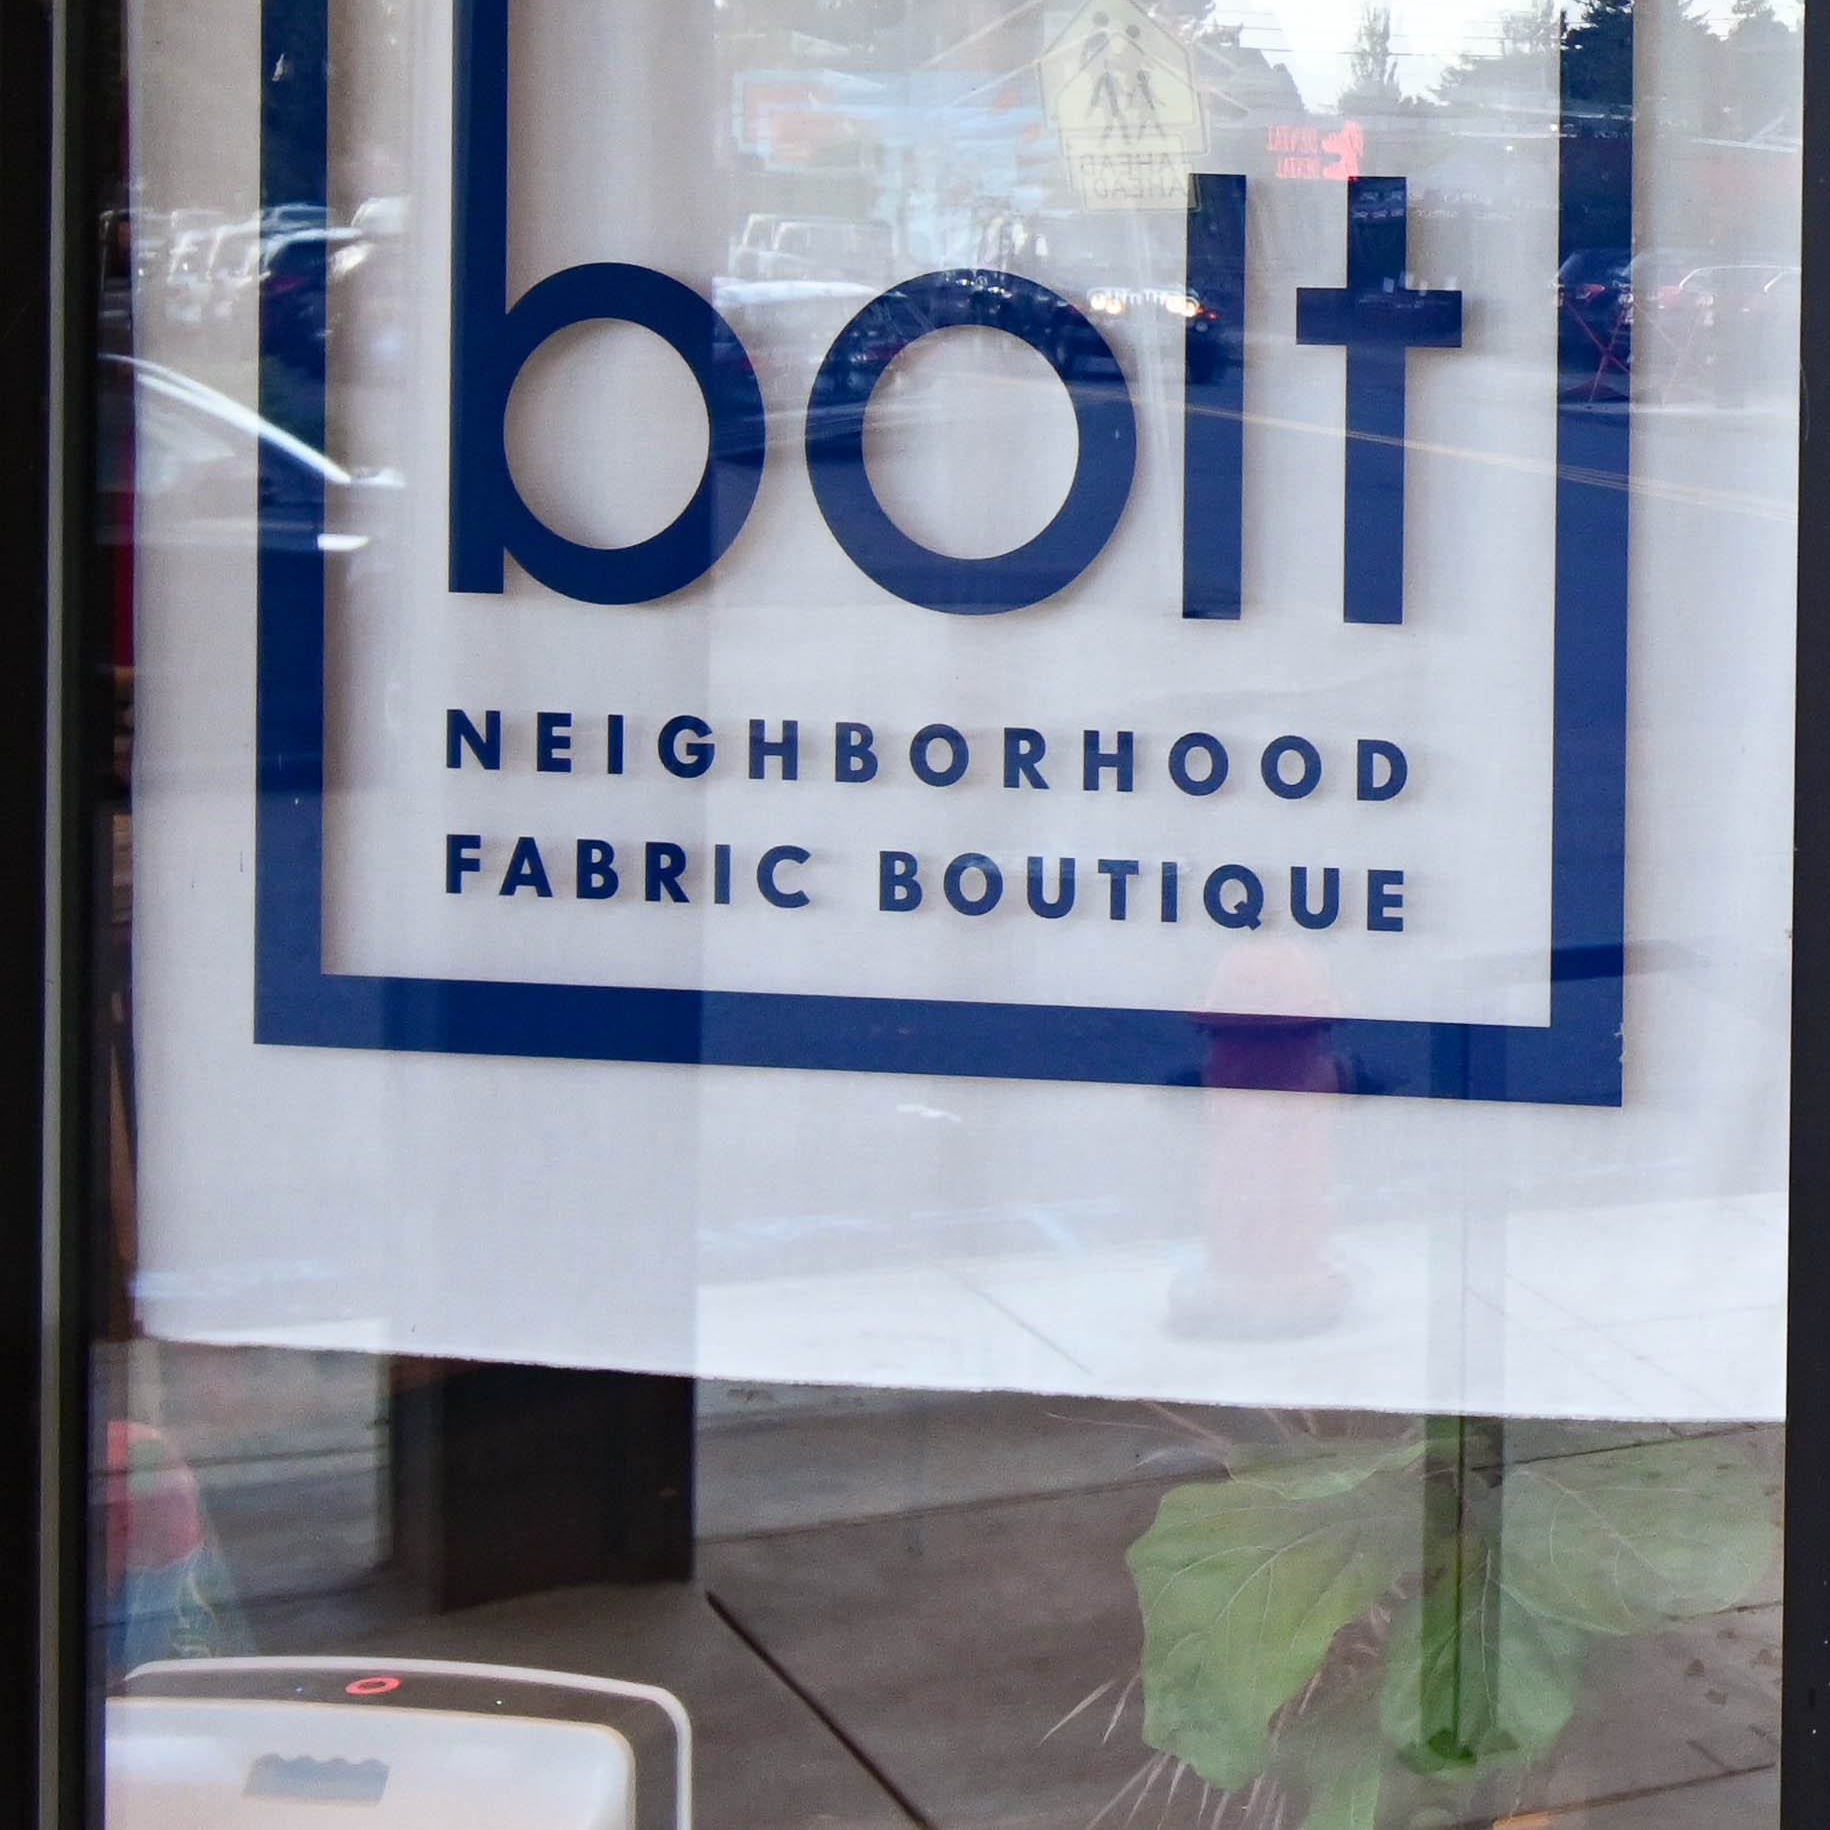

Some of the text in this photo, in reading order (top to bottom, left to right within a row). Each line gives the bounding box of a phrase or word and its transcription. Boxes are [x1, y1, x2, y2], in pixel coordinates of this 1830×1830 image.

[446, 707, 1409, 803] NEIGHBORHOOD
[446, 833, 1407, 933] FABRIC BOUTIQUE
